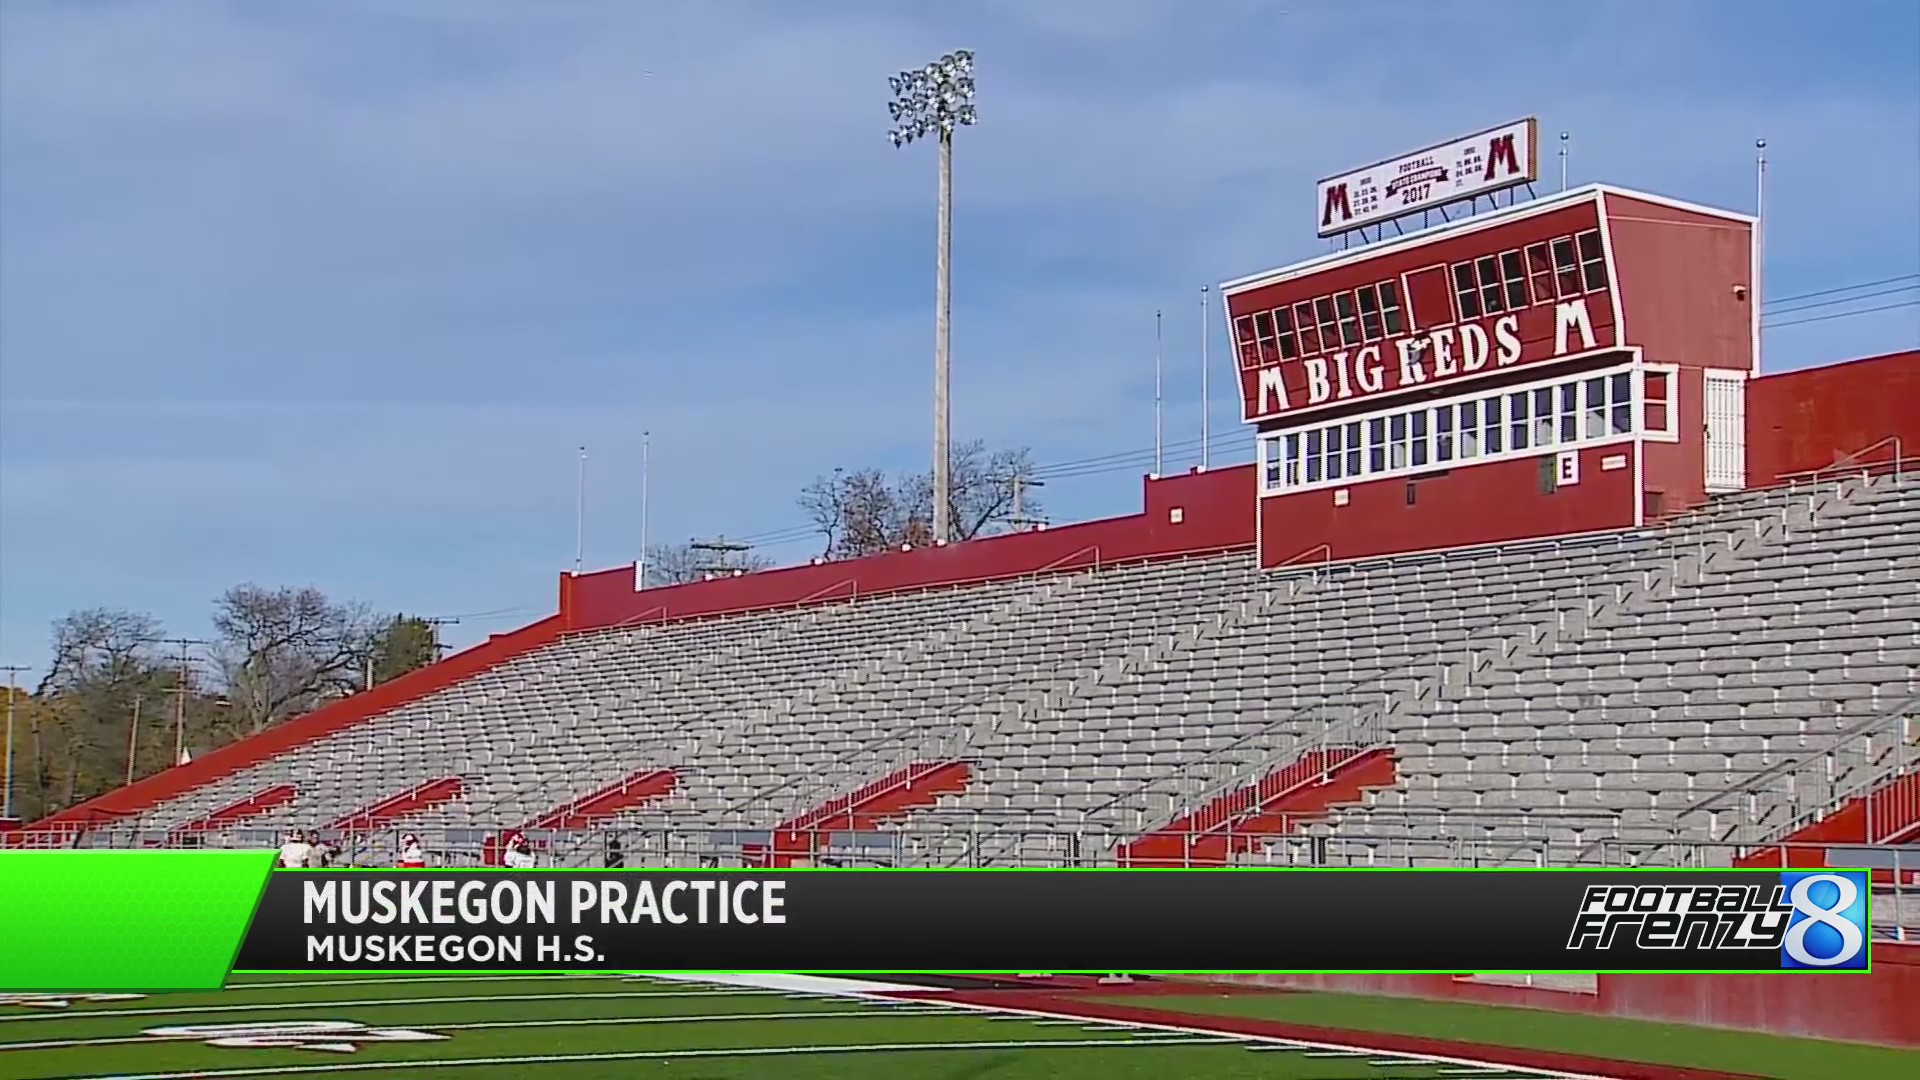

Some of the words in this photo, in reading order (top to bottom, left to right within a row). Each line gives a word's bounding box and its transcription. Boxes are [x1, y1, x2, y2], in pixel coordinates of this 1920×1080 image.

[1399, 156, 1434, 173] FOOTBALL
[1484, 133, 1520, 181] M
[1322, 183, 1353, 226] M
[1402, 184, 1431, 205] 2017
[1257, 365, 1290, 414] M
[1304, 346, 1386, 403] BIG
[1395, 314, 1521, 386] REDS
[1554, 300, 1597, 356] M
[1561, 456, 1574, 480] E
